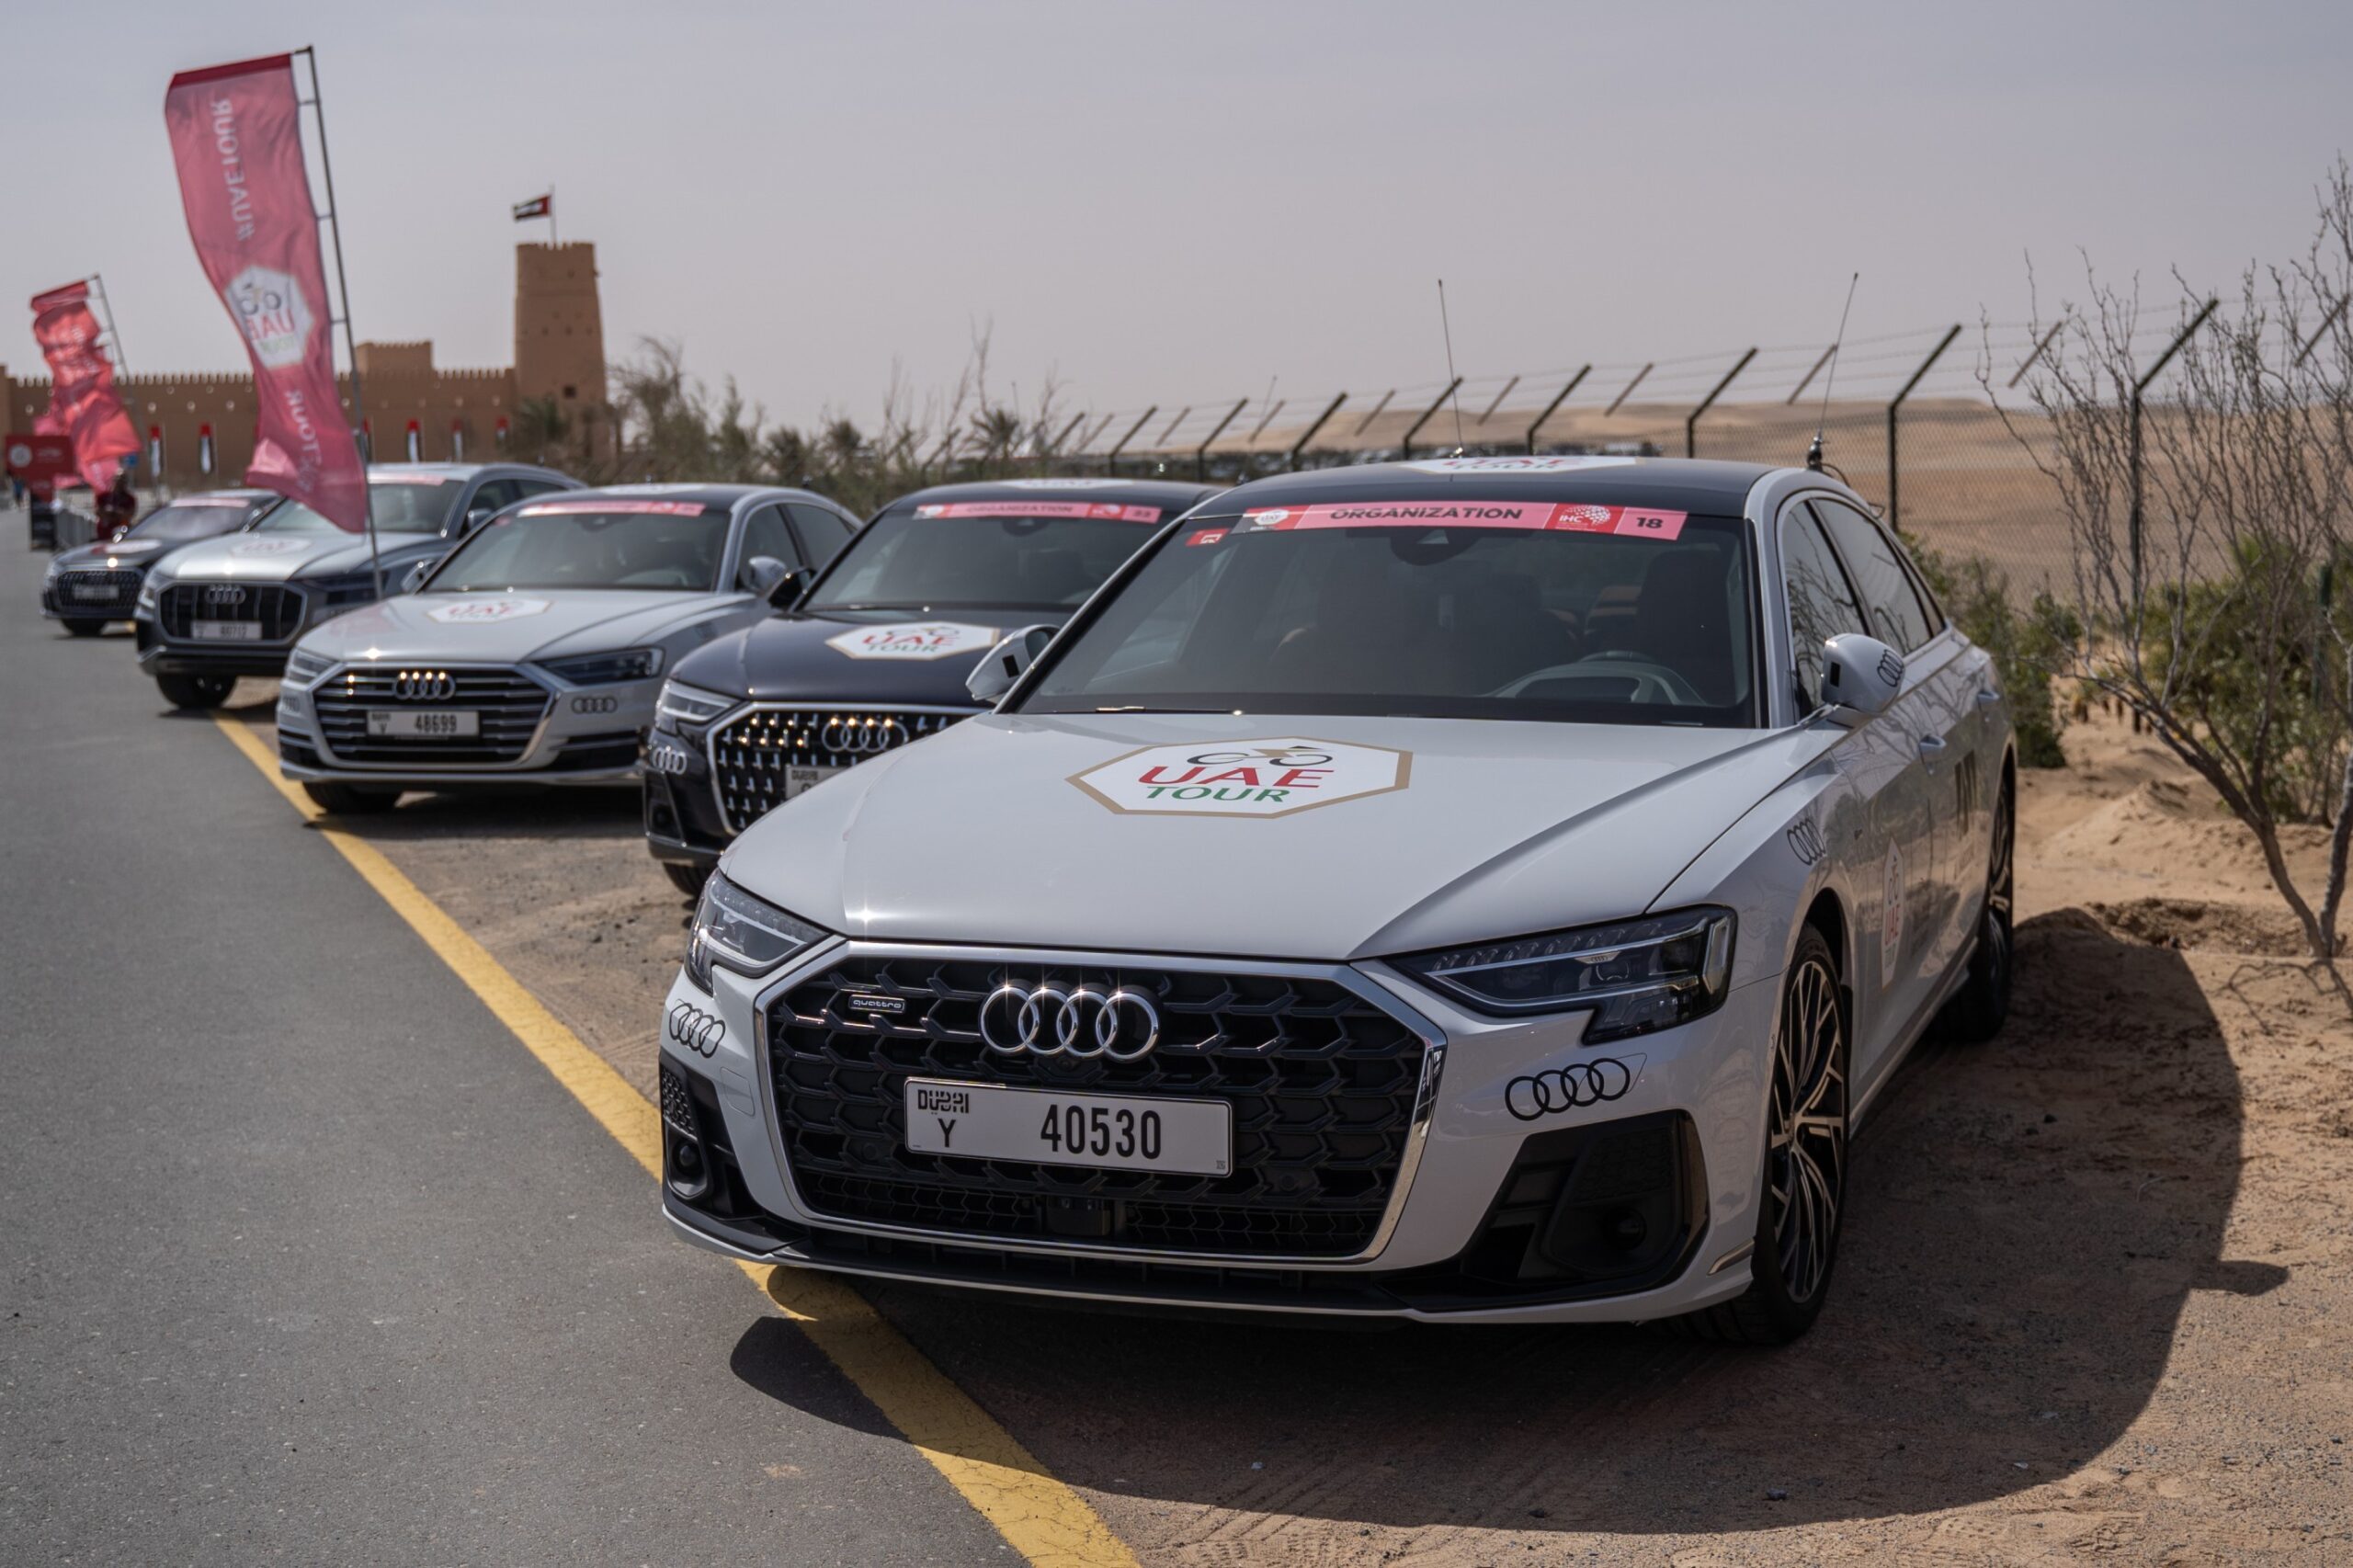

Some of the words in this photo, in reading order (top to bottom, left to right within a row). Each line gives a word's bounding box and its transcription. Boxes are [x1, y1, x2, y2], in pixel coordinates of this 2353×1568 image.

[1331, 506, 1523, 519] ORGANIZATION
[1559, 514, 1584, 523] IHC
[1636, 517, 1664, 529] 18
[1138, 766, 1334, 789] UAE
[1146, 786, 1290, 802] TOUR
[853, 999, 902, 1009] quattro
[938, 1118, 957, 1148] Y
[1040, 1104, 1161, 1160] 40530
